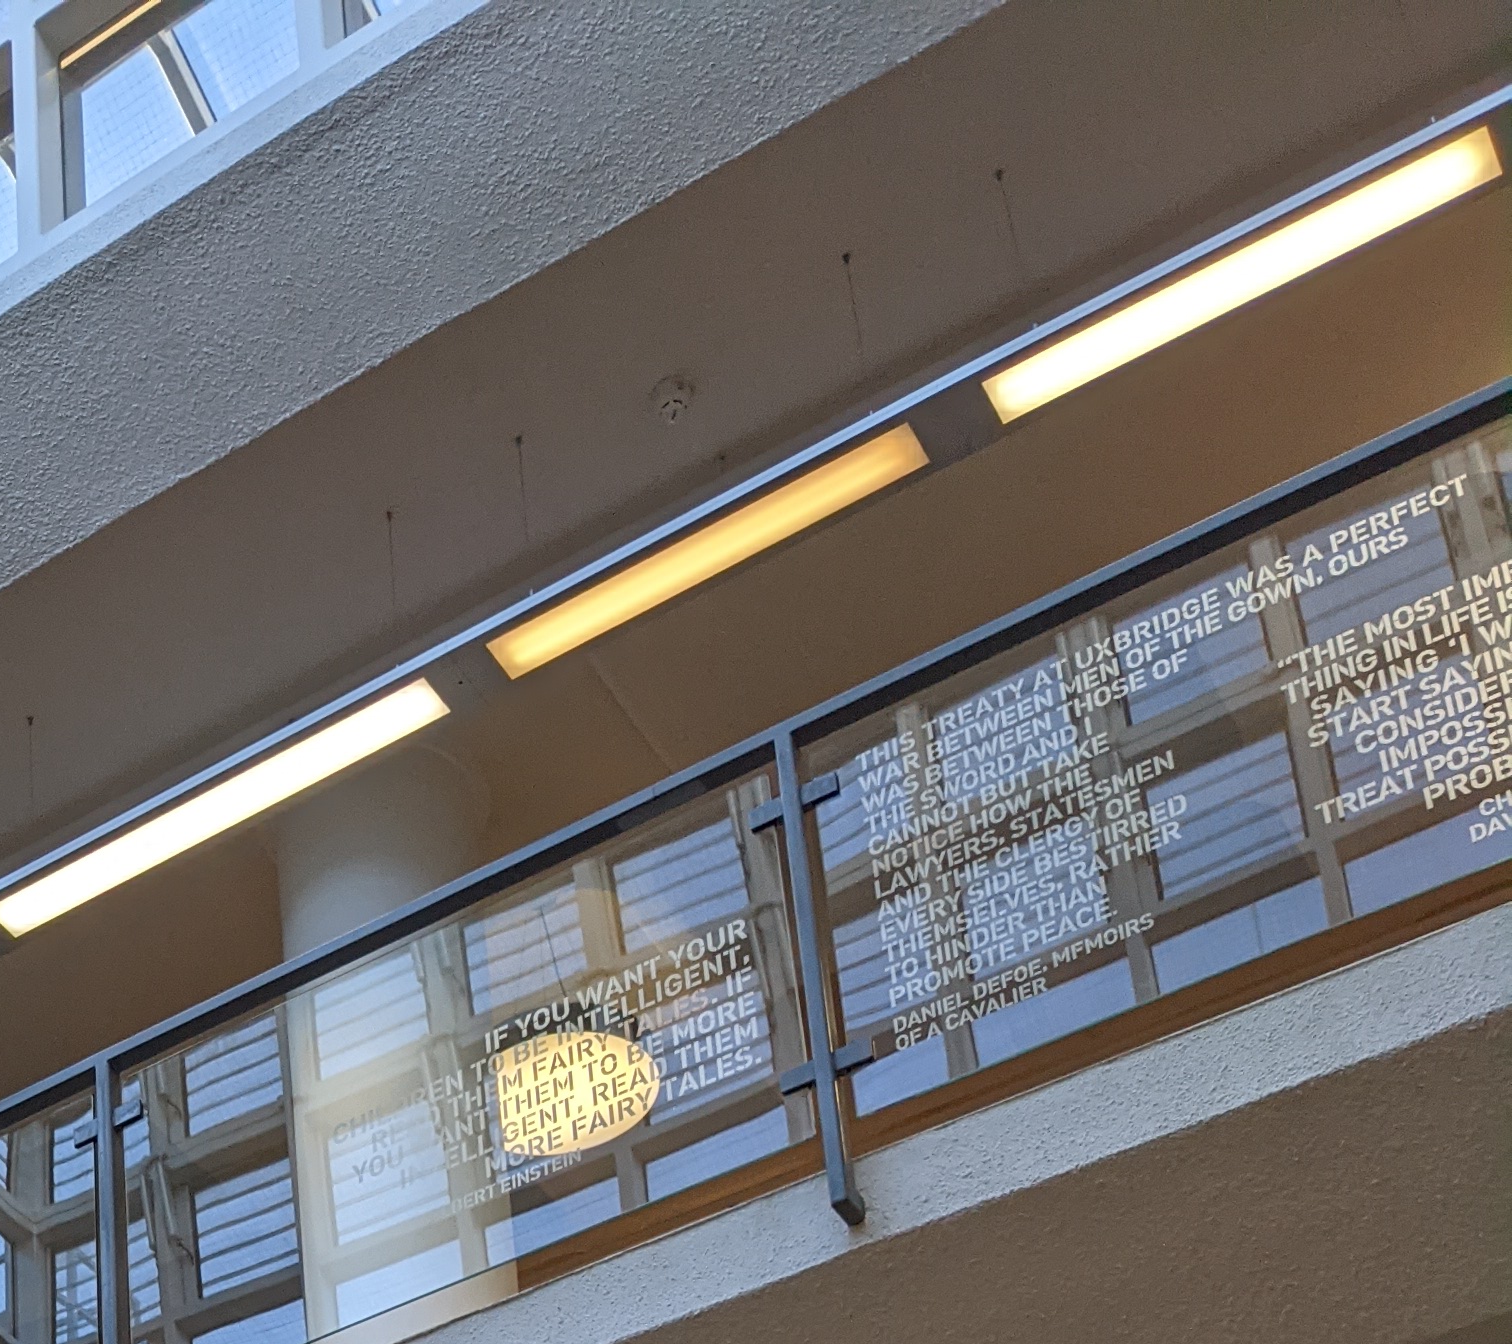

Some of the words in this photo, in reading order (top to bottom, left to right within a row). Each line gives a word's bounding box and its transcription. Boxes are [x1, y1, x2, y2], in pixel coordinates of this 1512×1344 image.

[855, 728, 915, 774] THIS
[923, 678, 1023, 743] TREATY
[1032, 659, 1065, 693] AT
[1074, 588, 1220, 674] UXBRIDGE
[1226, 554, 1295, 604] WAS
[1303, 540, 1325, 569] A
[1329, 475, 1468, 557] PERFECT
[1363, 583, 1454, 644] MOST
[858, 748, 920, 796] WAR
[931, 687, 1053, 762] BETWEEN
[1064, 656, 1119, 701] MEN
[1126, 637, 1162, 673] OF
[1168, 610, 1220, 654] THE
[1329, 524, 1409, 580] OURS
[1310, 645, 1439, 721] SAYING
[1308, 683, 1411, 748] START
[1314, 763, 1418, 829] TREAT
[485, 1022, 511, 1054] IF
[514, 996, 569, 1041] YOU
[575, 955, 661, 1014] WANT
[667, 917, 748, 973] YOUR
[484, 1125, 563, 1179] MORE
[571, 1087, 653, 1142] FAIRY
[500, 1147, 582, 1194] EINSTEIN
